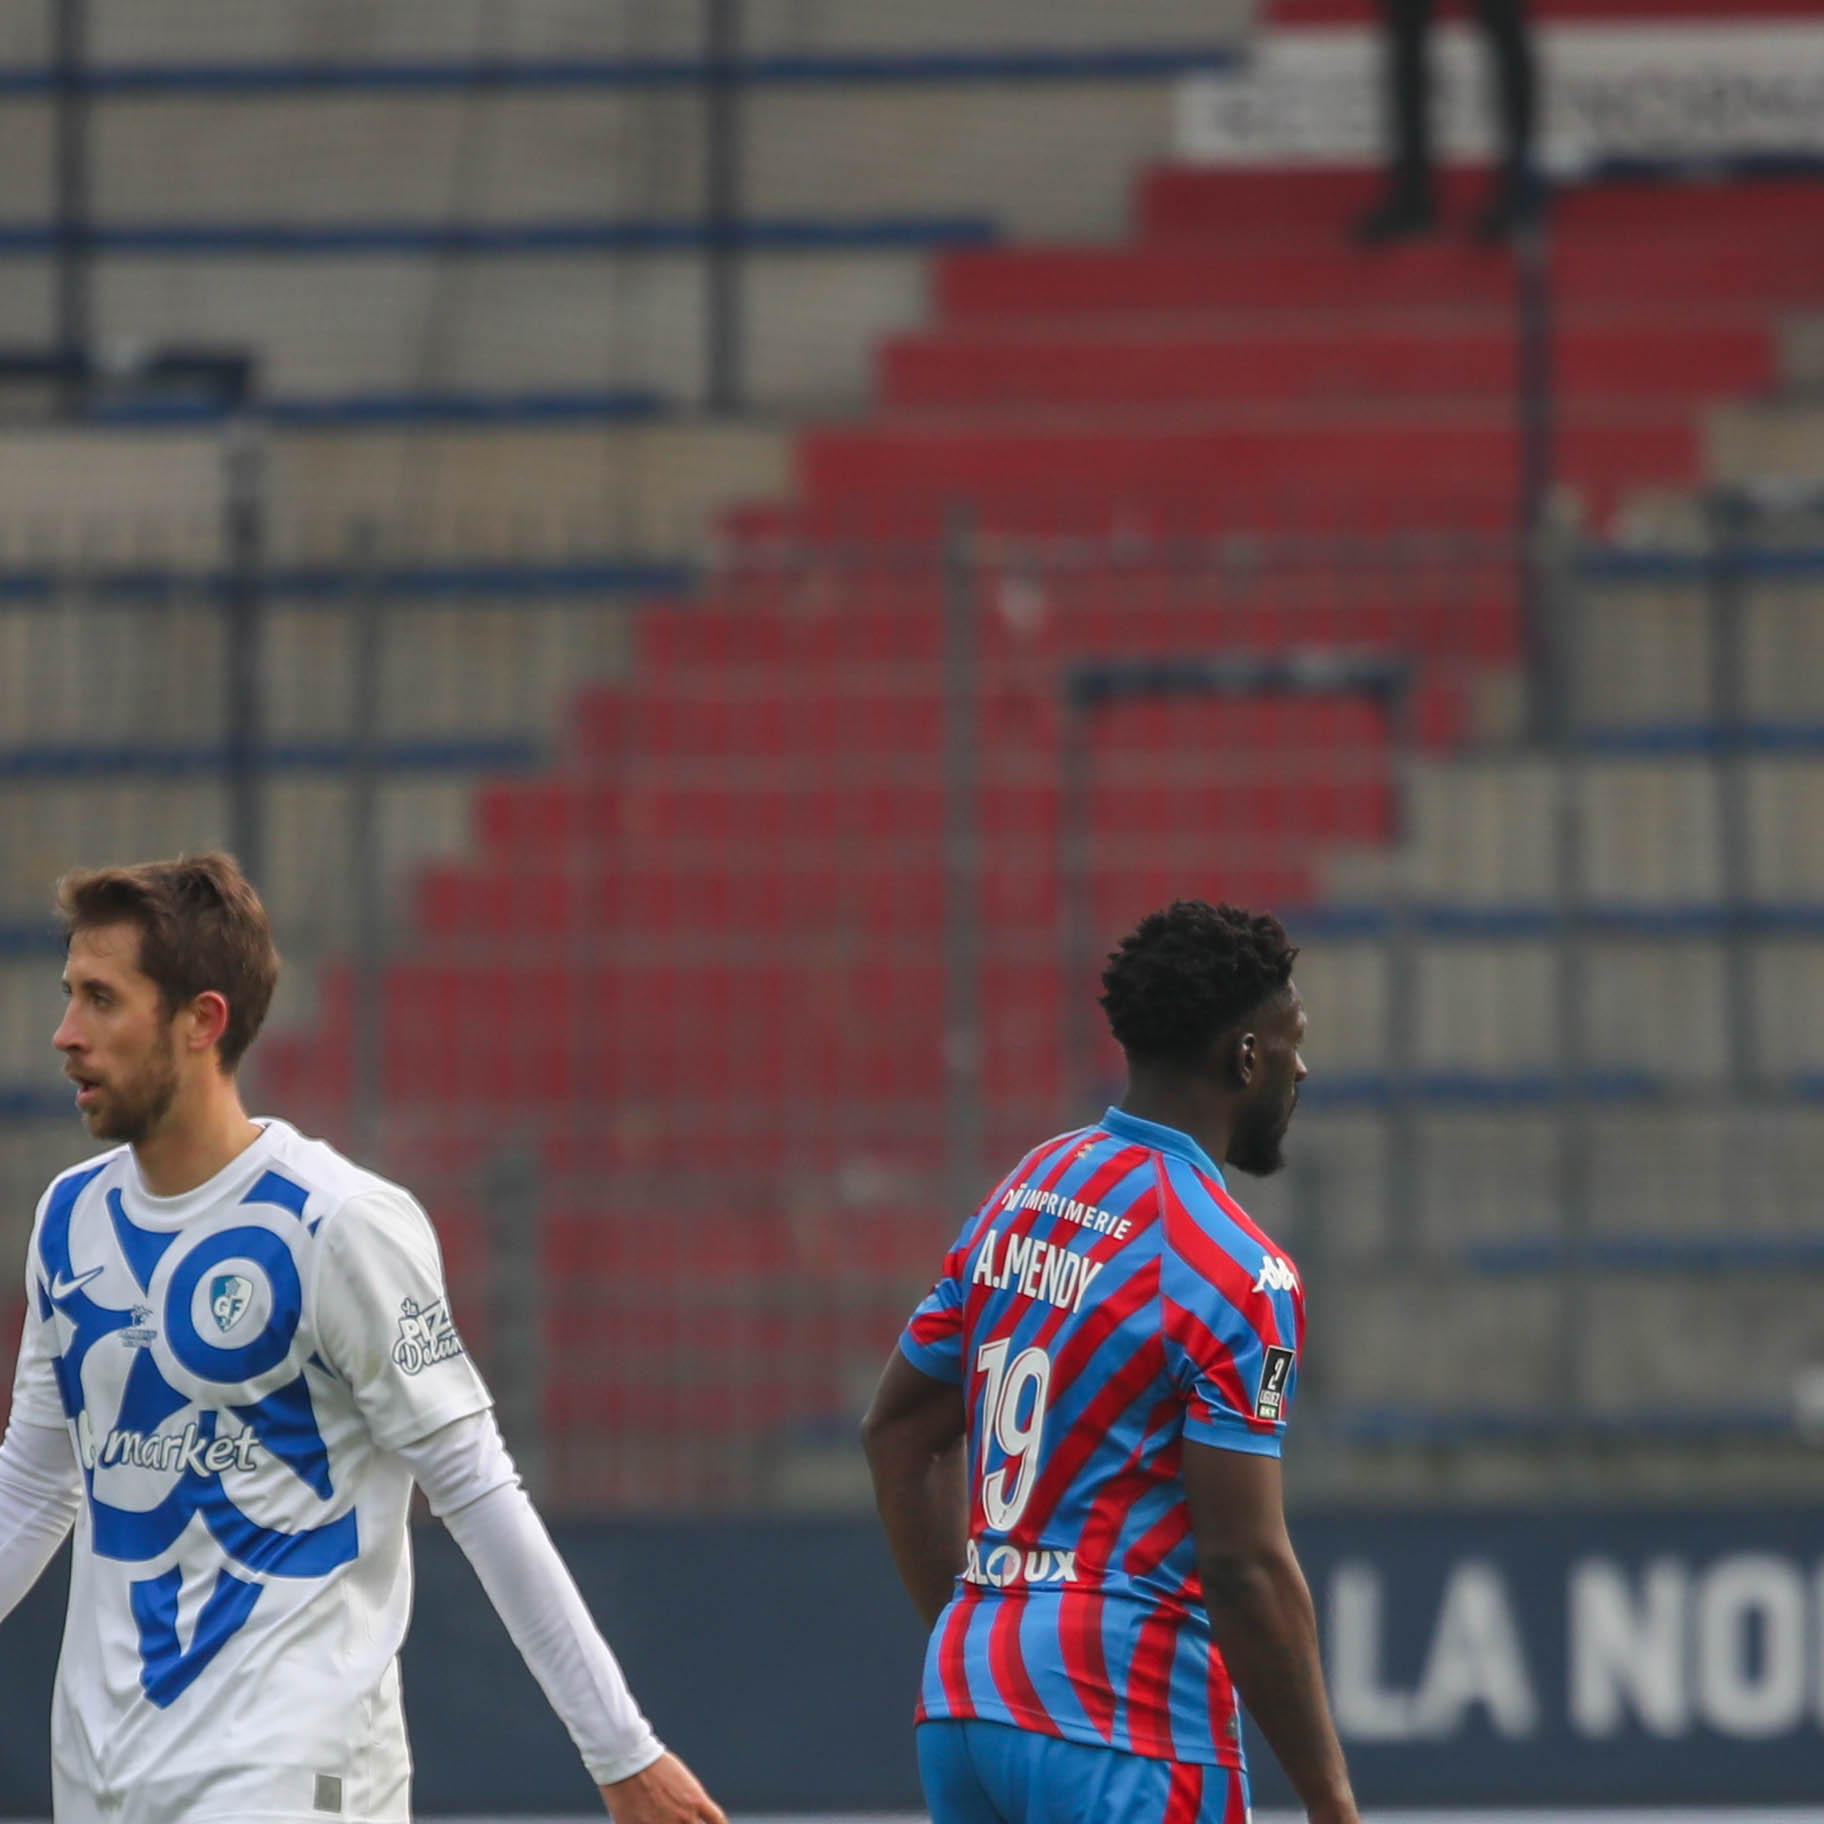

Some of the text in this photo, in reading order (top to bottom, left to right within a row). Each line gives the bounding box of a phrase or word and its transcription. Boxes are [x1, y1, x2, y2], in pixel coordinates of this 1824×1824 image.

[1020, 1189, 1132, 1241] IMPRIMERIE
[972, 1228, 1105, 1314] A.MENDY
[102, 1422, 262, 1479] market
[976, 1337, 1051, 1533] 19
[1331, 1556, 1537, 1741] LA
